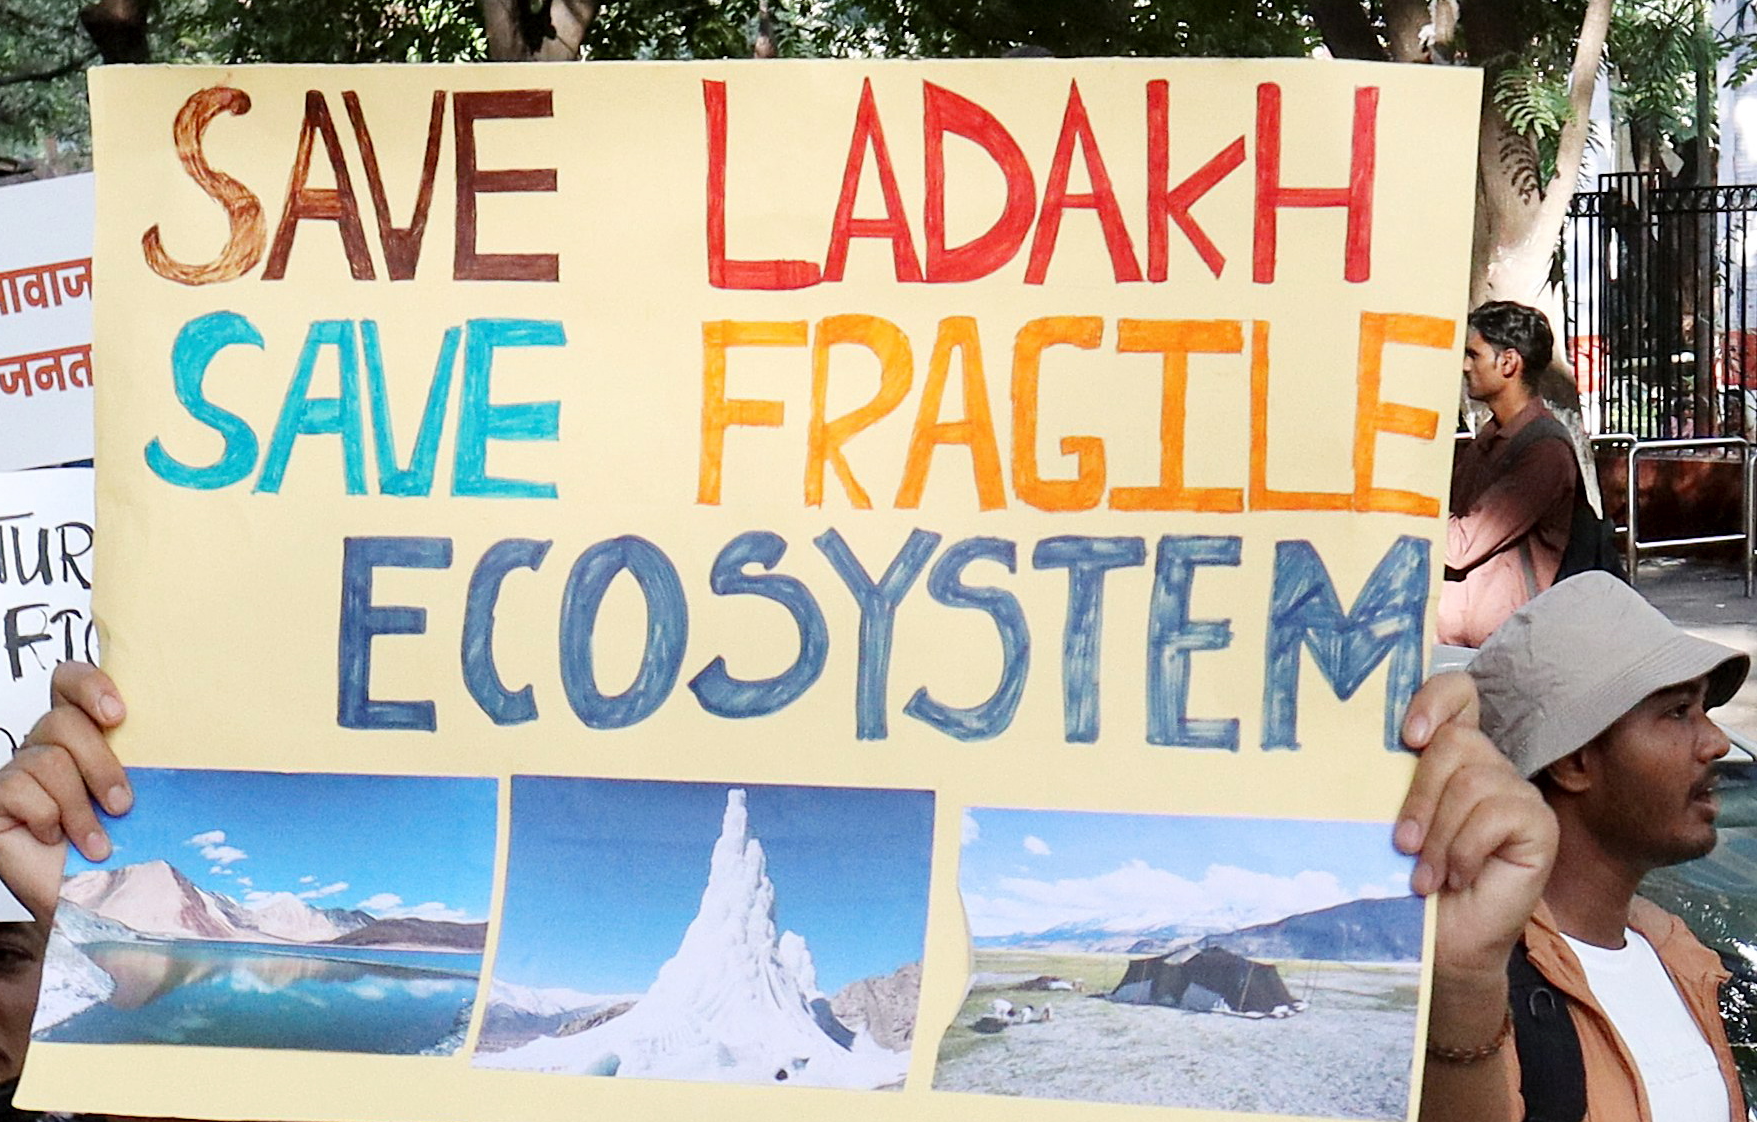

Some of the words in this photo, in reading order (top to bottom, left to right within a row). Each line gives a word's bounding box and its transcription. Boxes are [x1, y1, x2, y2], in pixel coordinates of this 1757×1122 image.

[142, 86, 559, 286] SAVE
[701, 78, 1380, 291] LADAKH
[144, 309, 569, 498] SAVE
[693, 311, 1456, 518] FRAGILE
[336, 528, 1432, 752] ECOSYSTEM
